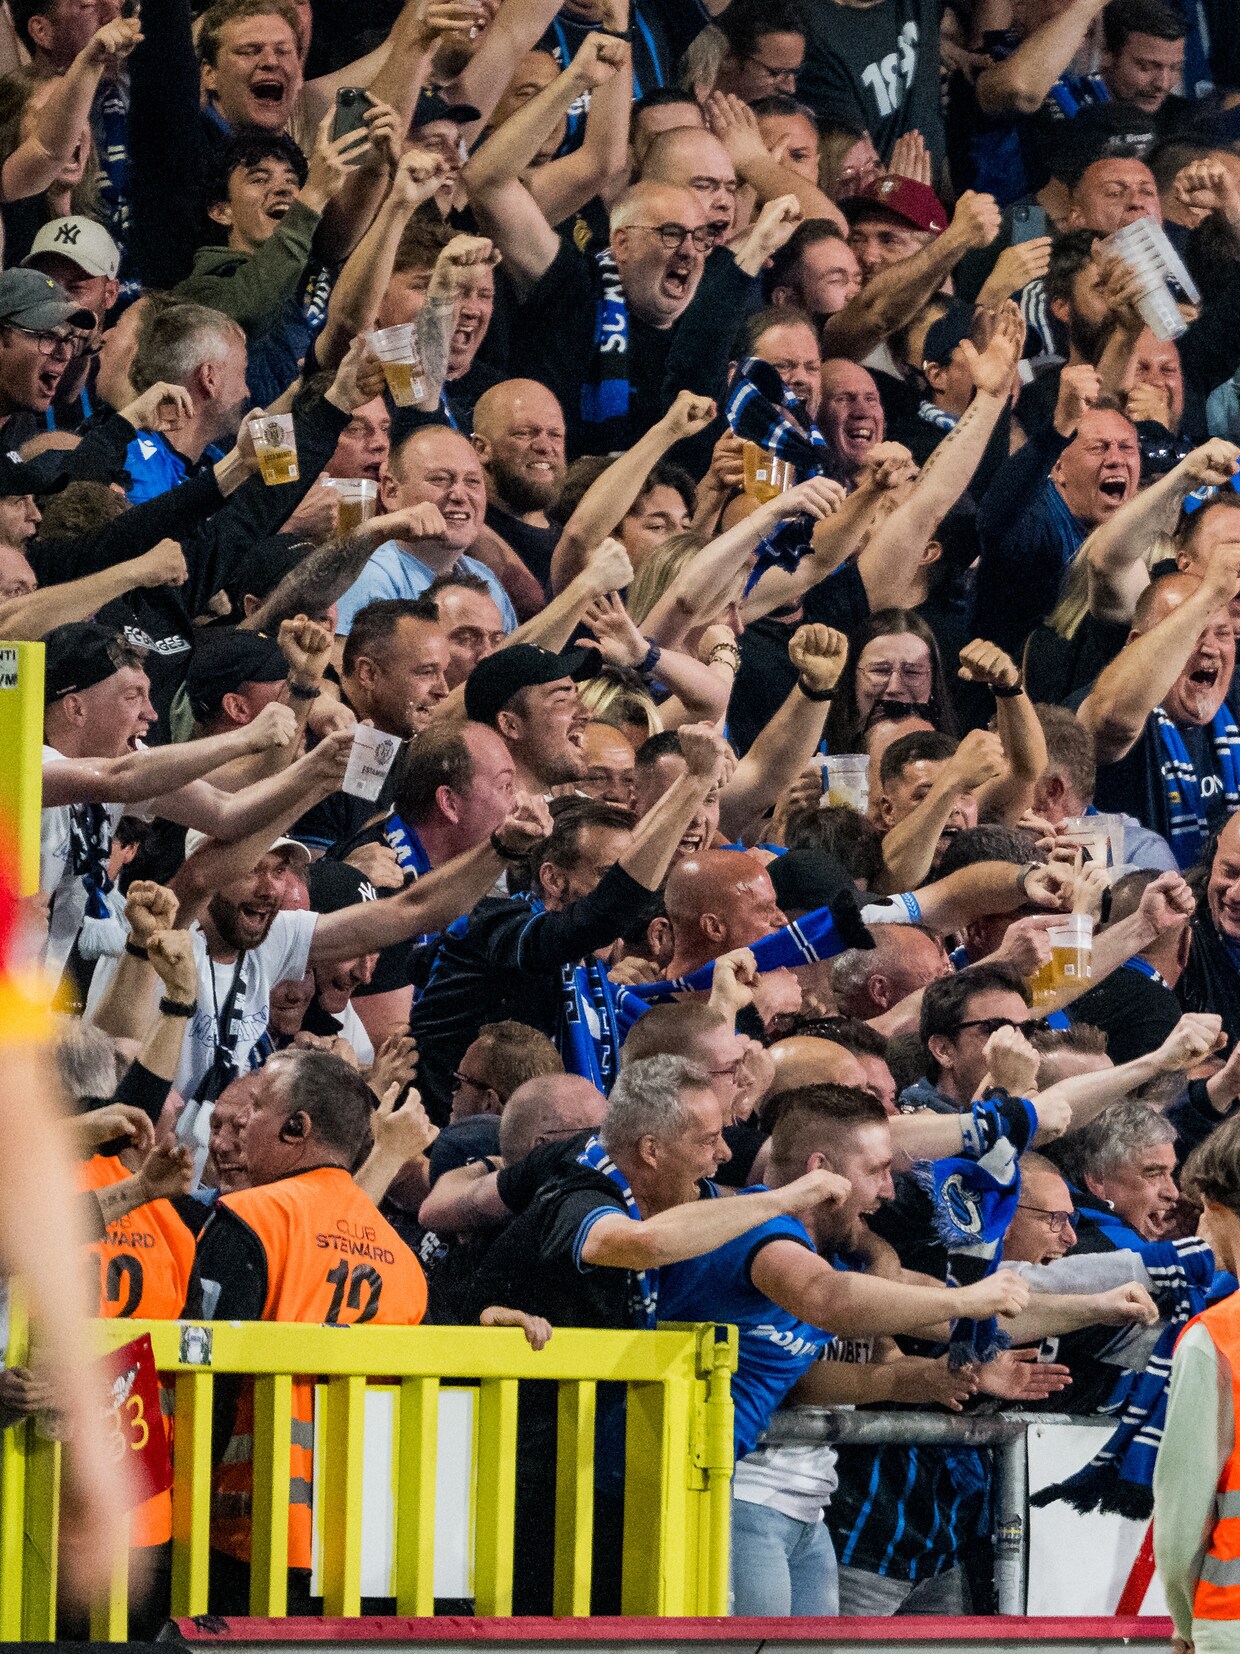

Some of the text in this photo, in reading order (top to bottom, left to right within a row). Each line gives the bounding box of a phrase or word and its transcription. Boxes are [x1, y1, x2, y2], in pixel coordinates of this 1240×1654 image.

[54, 223, 81, 245] NY
[336, 1219, 376, 1242] CLUB
[316, 1232, 394, 1265] STEWARD
